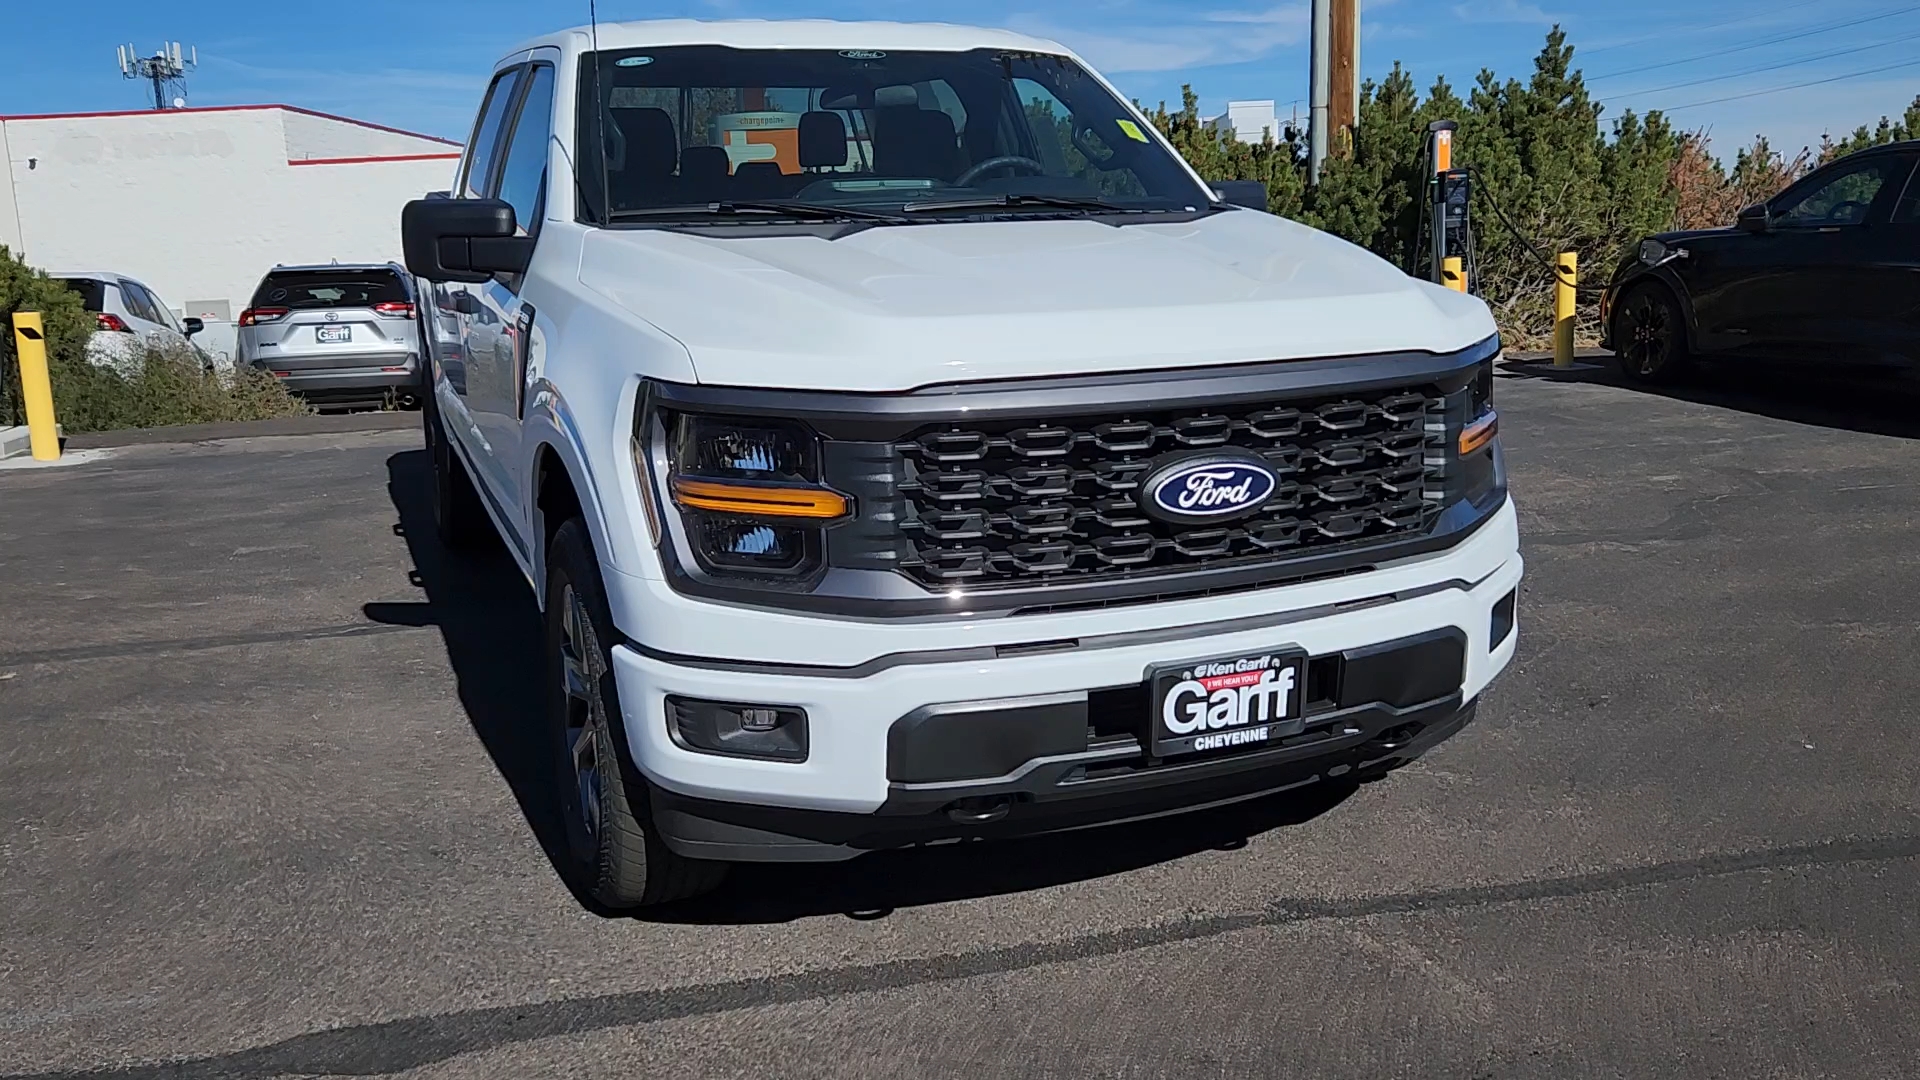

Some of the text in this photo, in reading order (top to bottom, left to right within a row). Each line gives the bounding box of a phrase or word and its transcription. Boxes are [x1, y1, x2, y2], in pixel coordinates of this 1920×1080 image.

[318, 328, 350, 341] Garff
[1178, 471, 1253, 508] Ford
[1206, 655, 1271, 677] Ken Garff
[1211, 675, 1254, 687] WE HEAR YOU
[1163, 667, 1295, 734] Garff
[1194, 726, 1268, 751] CHEYENNE
